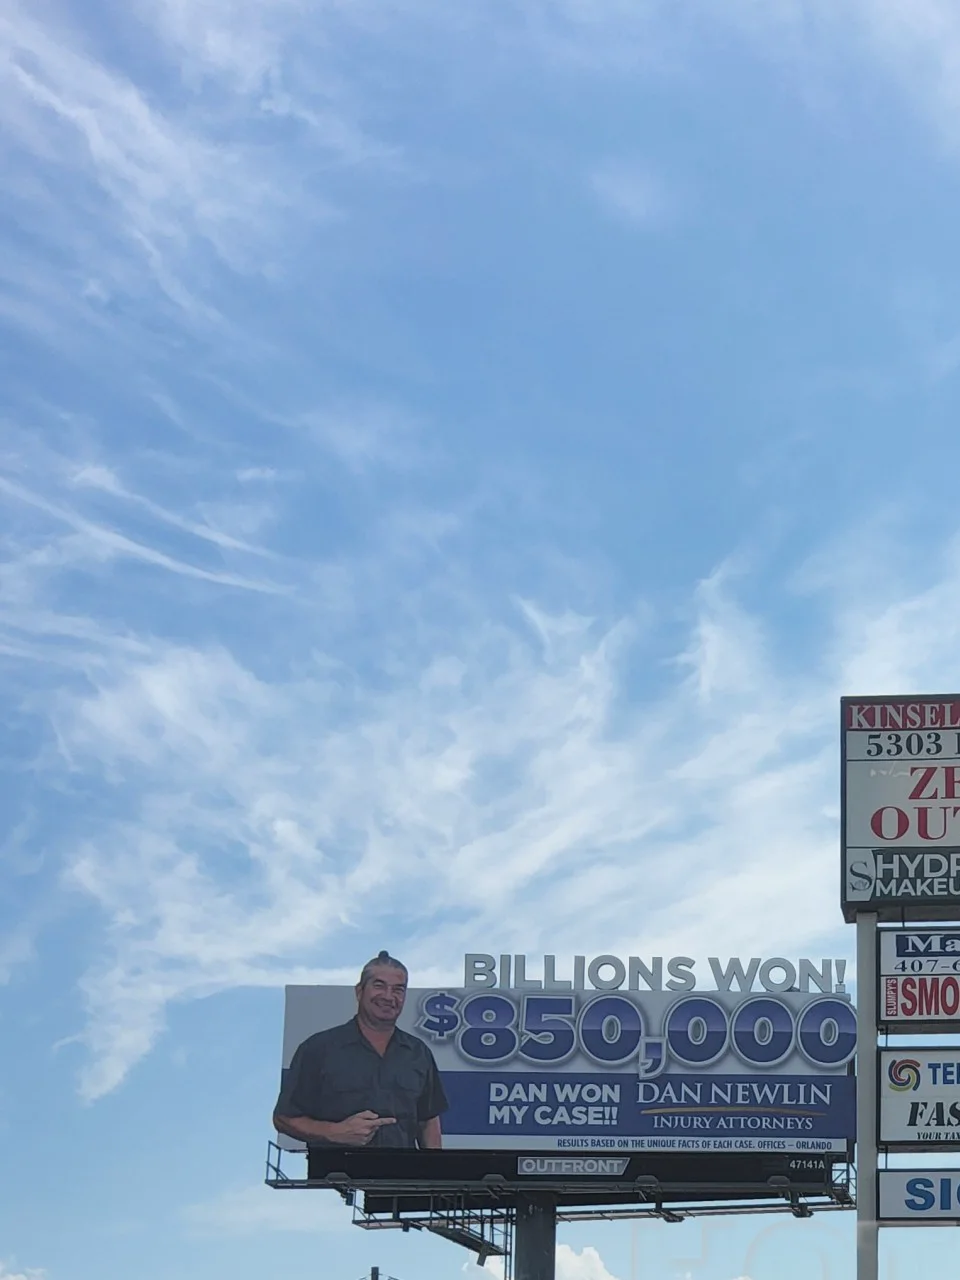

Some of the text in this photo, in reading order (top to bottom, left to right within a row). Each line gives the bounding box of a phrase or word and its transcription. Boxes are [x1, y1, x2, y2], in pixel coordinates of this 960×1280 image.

[866, 732, 943, 757] 5303
[464, 953, 847, 993] BILLIONS WON!
[886, 978, 897, 1016] SLUMPY'S
[420, 991, 857, 1079] $850,000
[489, 1083, 621, 1103] DAN WON
[636, 1082, 832, 1106] DAN NEWLIN
[488, 1105, 618, 1126] MY CASE!!
[653, 1115, 813, 1131] INJURY ATTORNEYS
[557, 1139, 588, 1148] RESULTS
[591, 1139, 615, 1148] BASED
[617, 1139, 628, 1148] ON
[630, 1139, 645, 1148] THE
[648, 1139, 676, 1149] UNIQUE
[678, 1140, 700, 1149] FACTS
[701, 1140, 712, 1149] OF
[713, 1141, 733, 1149] EACH
[758, 1141, 786, 1149] OFFICES
[796, 1141, 832, 1150] ORLANDO
[917, 1132, 941, 1140] YOUR
[521, 1159, 624, 1173] OUTFRONT
[790, 1160, 825, 1169] 47141A
